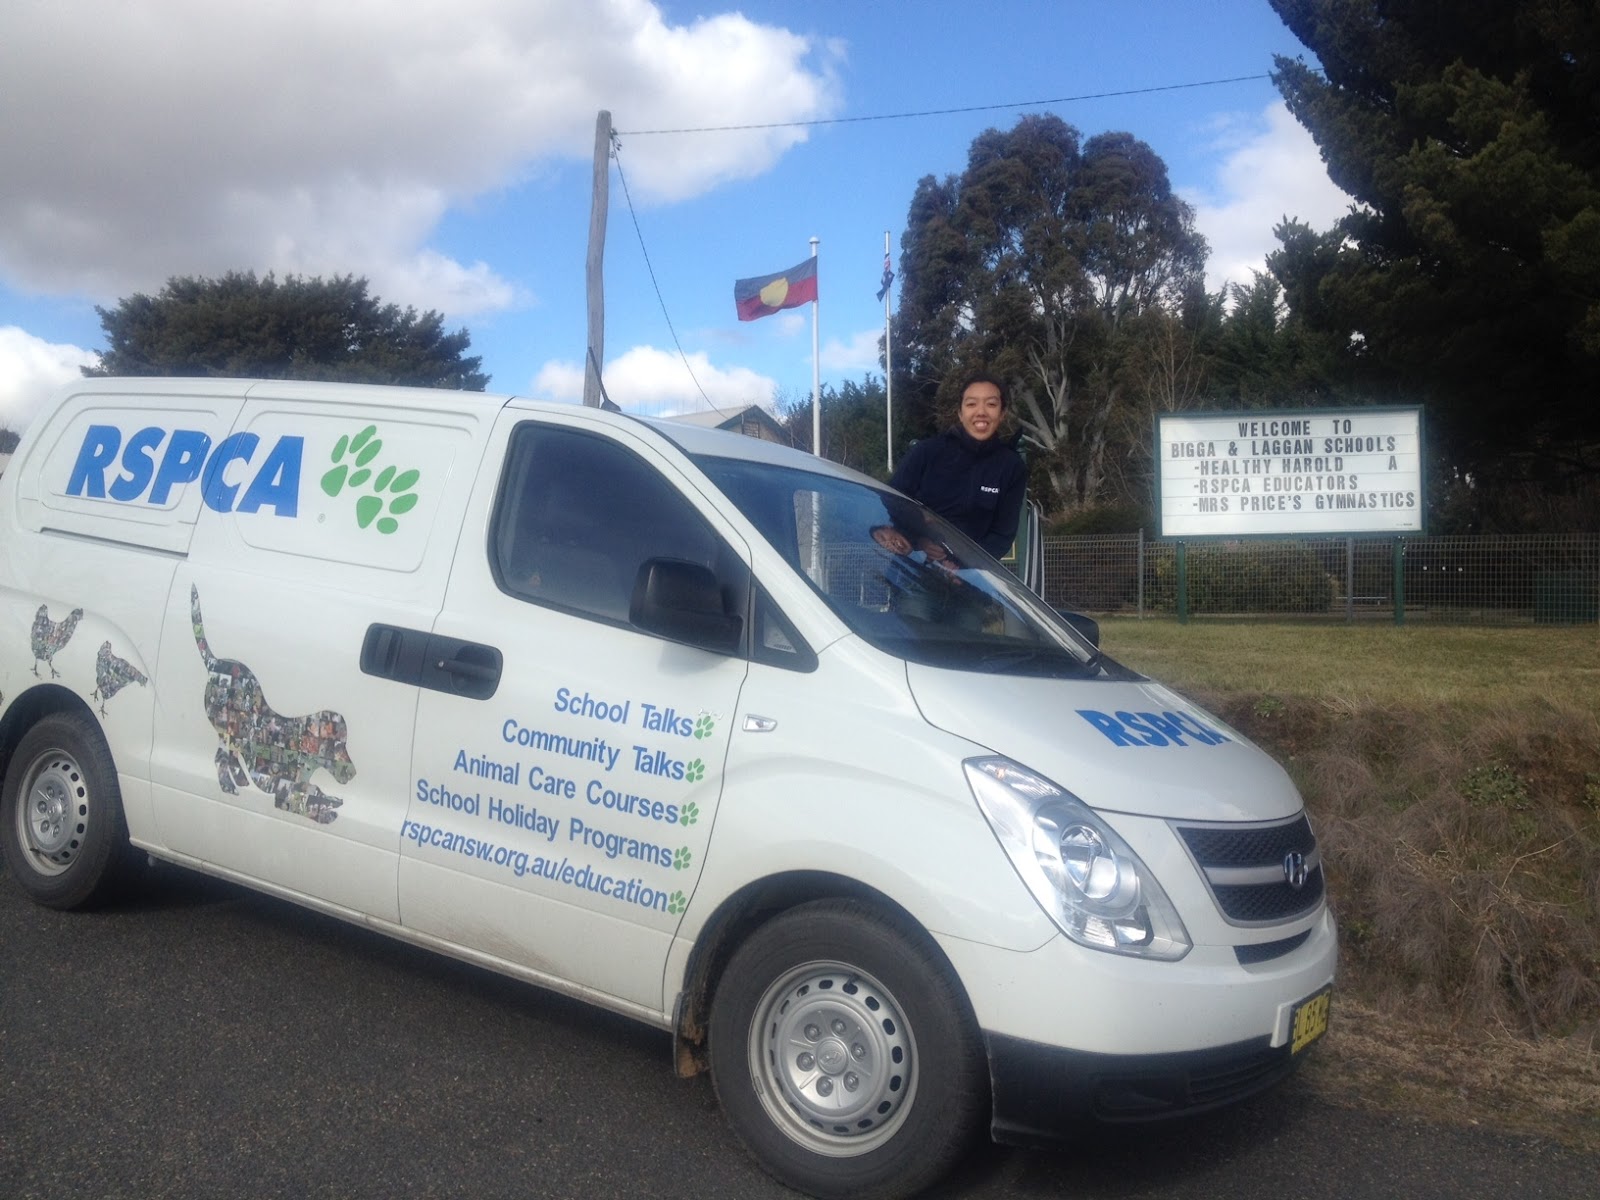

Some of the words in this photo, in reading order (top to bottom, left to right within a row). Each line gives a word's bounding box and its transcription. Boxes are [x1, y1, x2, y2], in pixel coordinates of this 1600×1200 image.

[1171, 441, 1216, 458] BIGGA
[1228, 440, 1238, 457] &
[1252, 439, 1313, 456] LAGGAN
[1324, 436, 1396, 453] SCHOOLS
[1238, 420, 1311, 438] WELCOME
[1332, 419, 1352, 435] TO
[65, 424, 305, 518] RSPCA
[1263, 475, 1358, 492] EDUCATORS
[1282, 456, 1344, 474] HAROLD
[1388, 455, 1397, 471] A
[1240, 494, 1302, 511] PRICE'S
[1315, 492, 1415, 510] GYMNASTICS
[554, 687, 630, 725] School
[640, 703, 693, 738] Talks
[1074, 710, 1232, 747] RSPCA
[502, 719, 621, 771] Community
[632, 745, 685, 781] Talks
[453, 749, 520, 786] Animal
[528, 766, 576, 799] Care
[586, 779, 679, 824] Courses
[416, 778, 480, 816] School
[488, 796, 560, 842] Holiday
[569, 817, 673, 869] Programs
[400, 818, 668, 912] rspcansw.org.au/education
